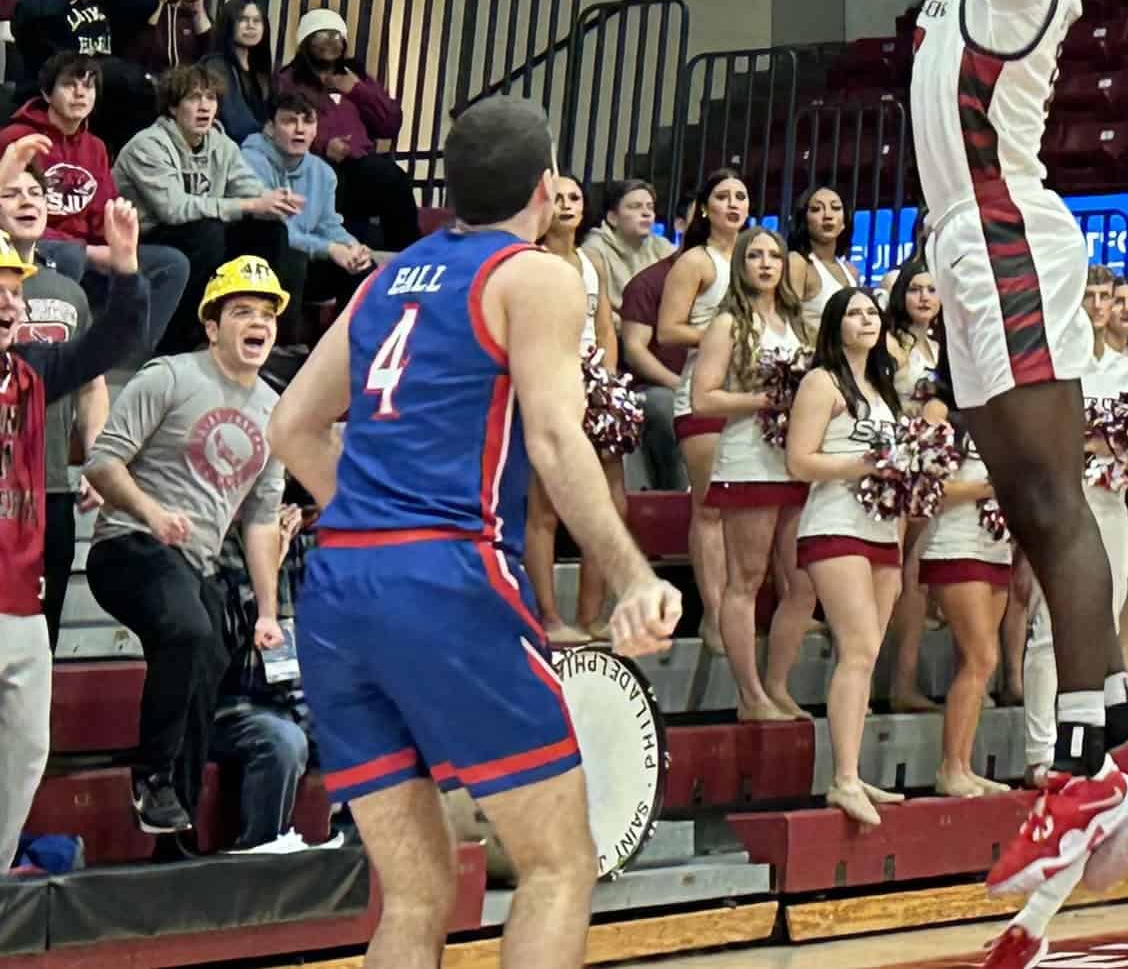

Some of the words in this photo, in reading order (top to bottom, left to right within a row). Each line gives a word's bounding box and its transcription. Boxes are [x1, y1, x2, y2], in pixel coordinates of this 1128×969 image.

[47, 194, 90, 211] SJU
[363, 303, 421, 420] 4
[614, 800, 650, 859] SAINT
